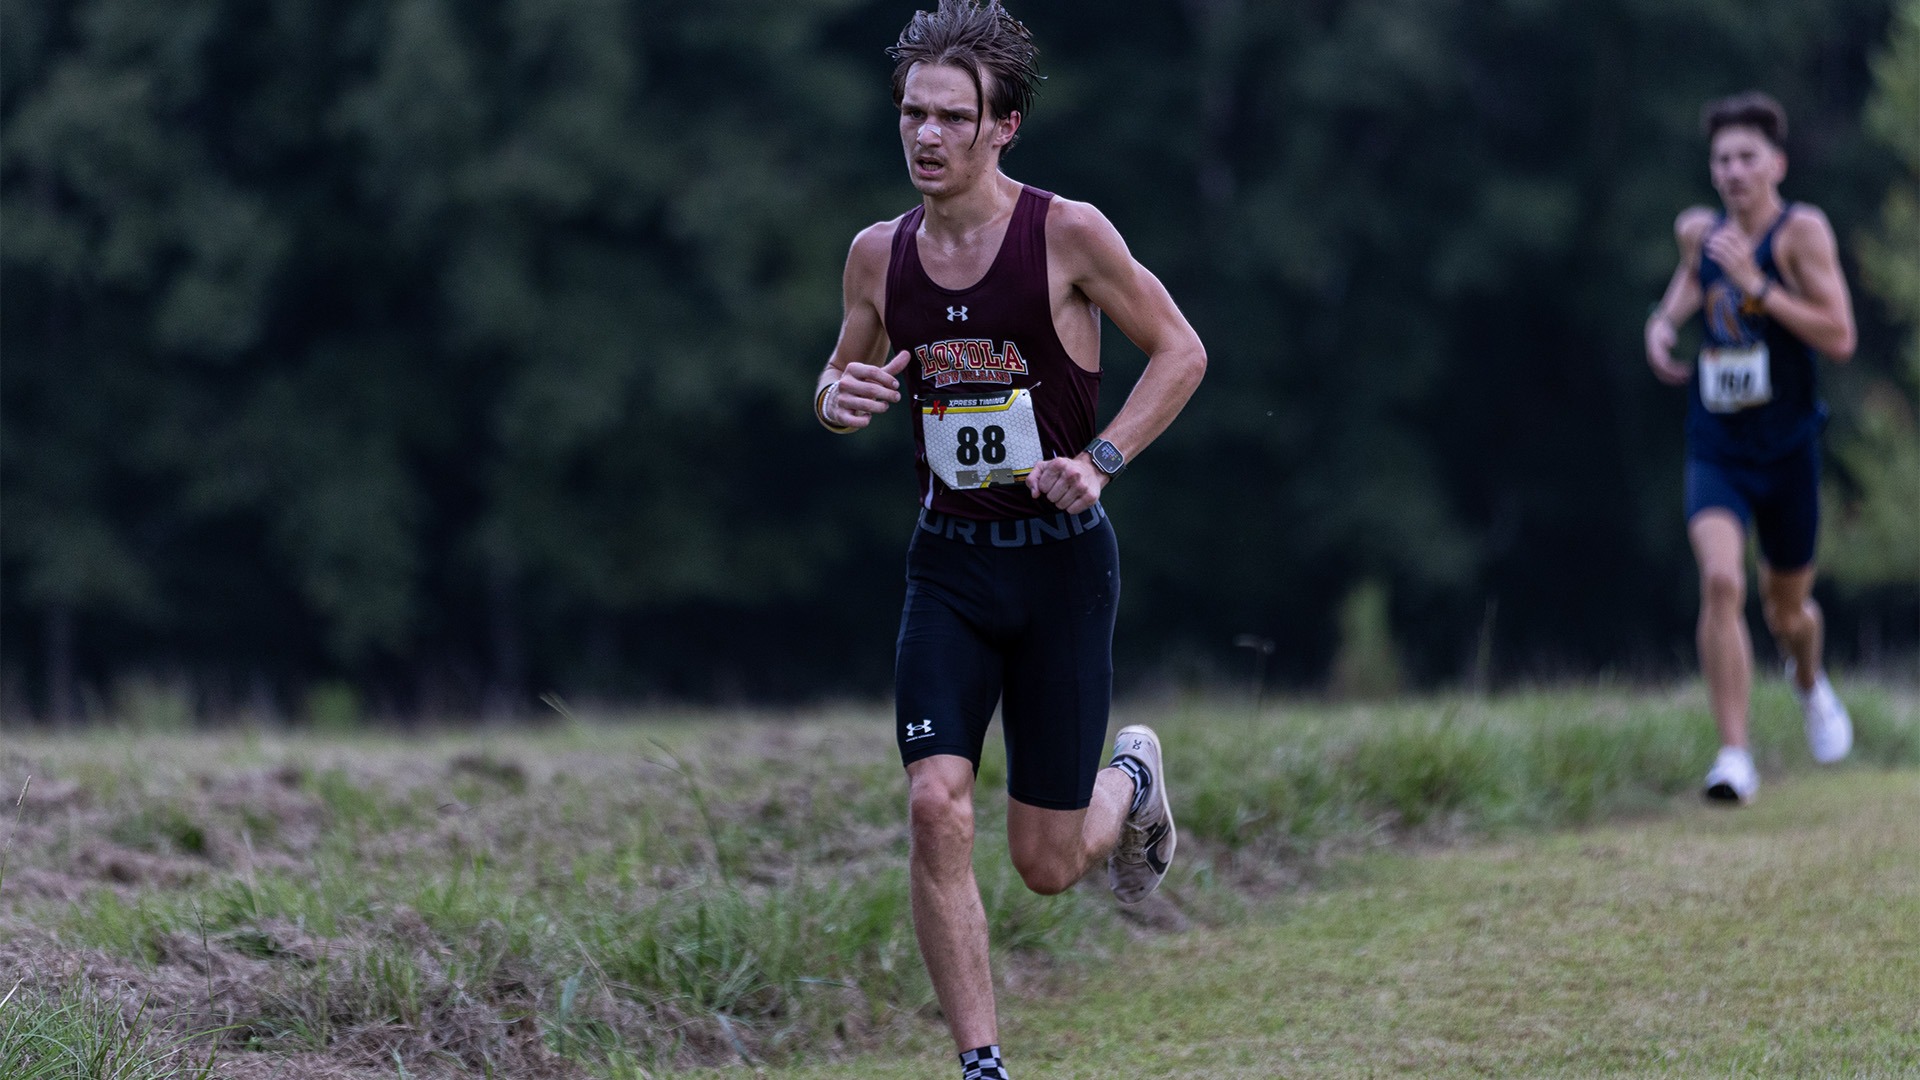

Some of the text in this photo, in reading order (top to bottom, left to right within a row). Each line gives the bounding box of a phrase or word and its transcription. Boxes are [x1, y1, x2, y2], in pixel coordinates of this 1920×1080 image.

[915, 339, 1028, 379] LOYOLA
[936, 370, 1011, 386] NEW ORLEANS
[948, 396, 1006, 407] XPRESS TIMING
[956, 424, 1006, 466] 88
